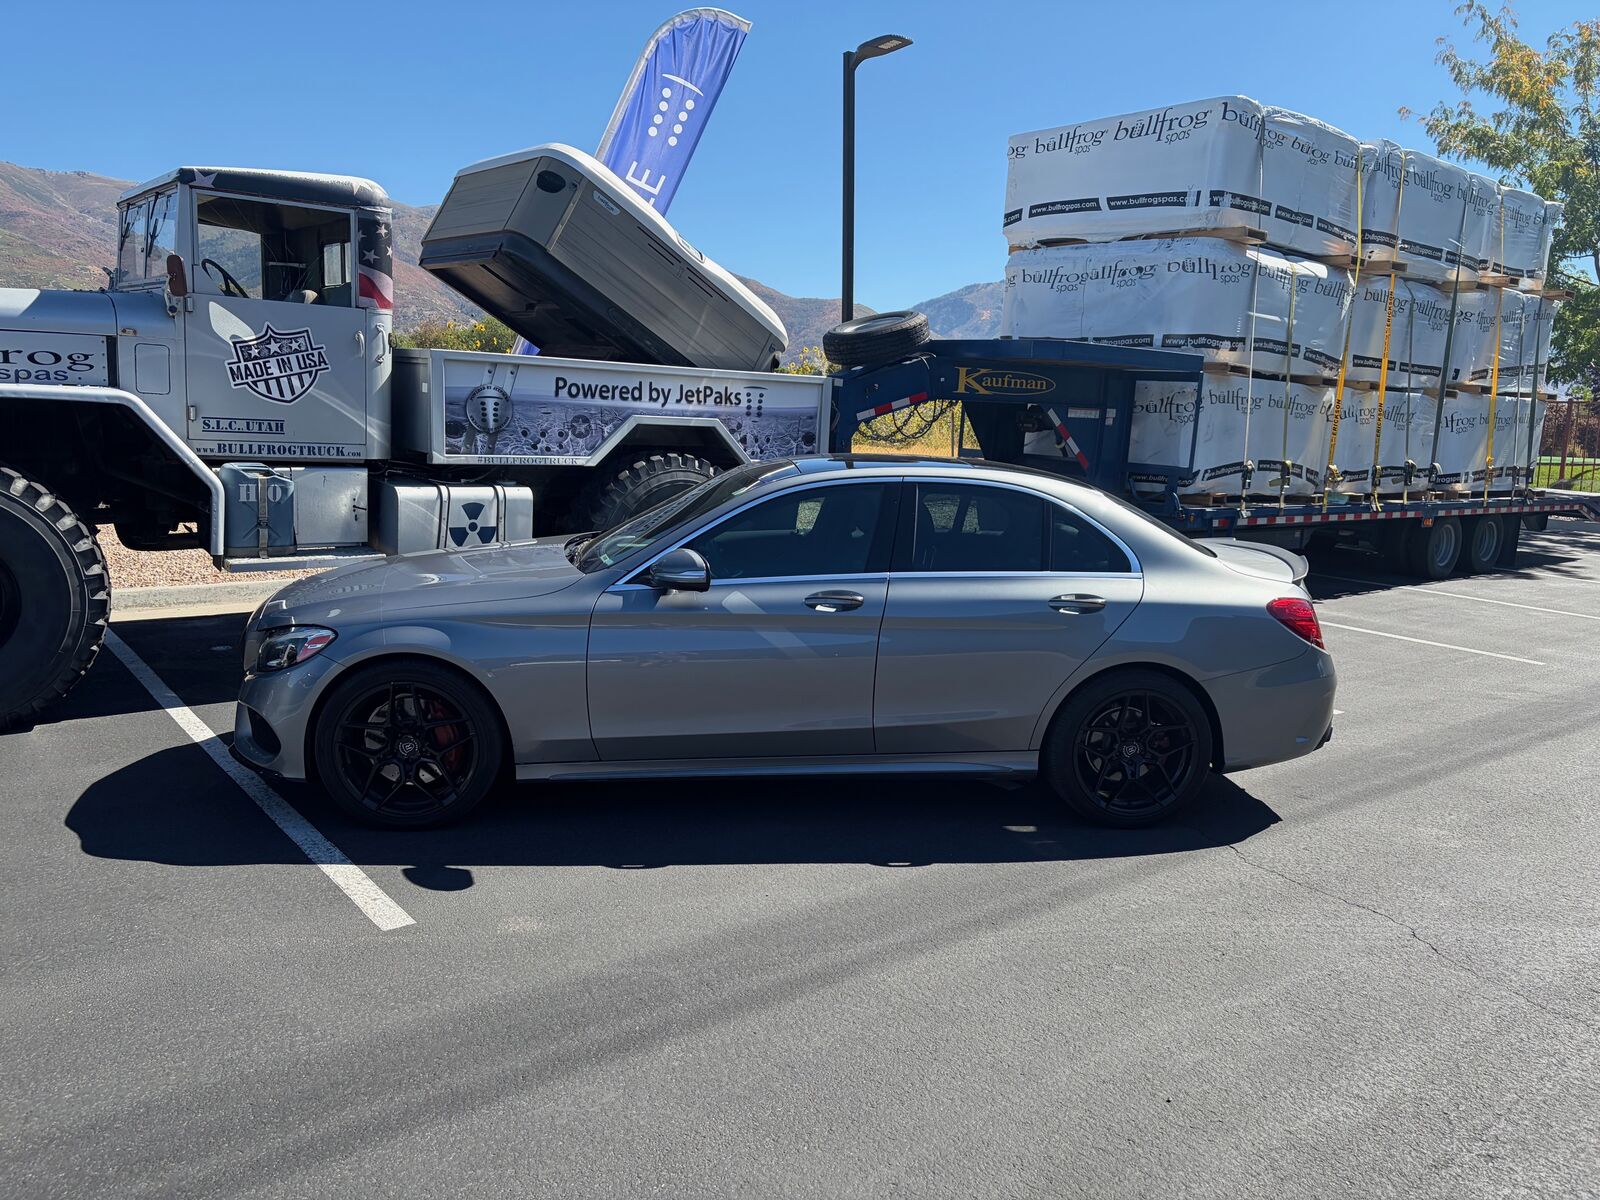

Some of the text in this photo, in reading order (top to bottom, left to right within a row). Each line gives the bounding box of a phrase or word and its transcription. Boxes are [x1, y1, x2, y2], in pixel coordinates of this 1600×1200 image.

[1165, 128, 1191, 145] spas
[1075, 144, 1091, 156] spas
[1031, 201, 1097, 214] www.bullfrogspas.com
[1116, 278, 1137, 289] spas
[1220, 274, 1240, 284] spas
[1055, 283, 1079, 294] spas
[229, 351, 329, 383] MADE IN USA
[953, 366, 1048, 395] Kaufman
[554, 376, 742, 408] Powered by JetPaks
[1332, 399, 1342, 437] ERICKSON
[1375, 402, 1384, 438] ERICKSON
[246, 421, 284, 432] UTAH
[477, 456, 578, 465] #BULLFROGTRUCK
